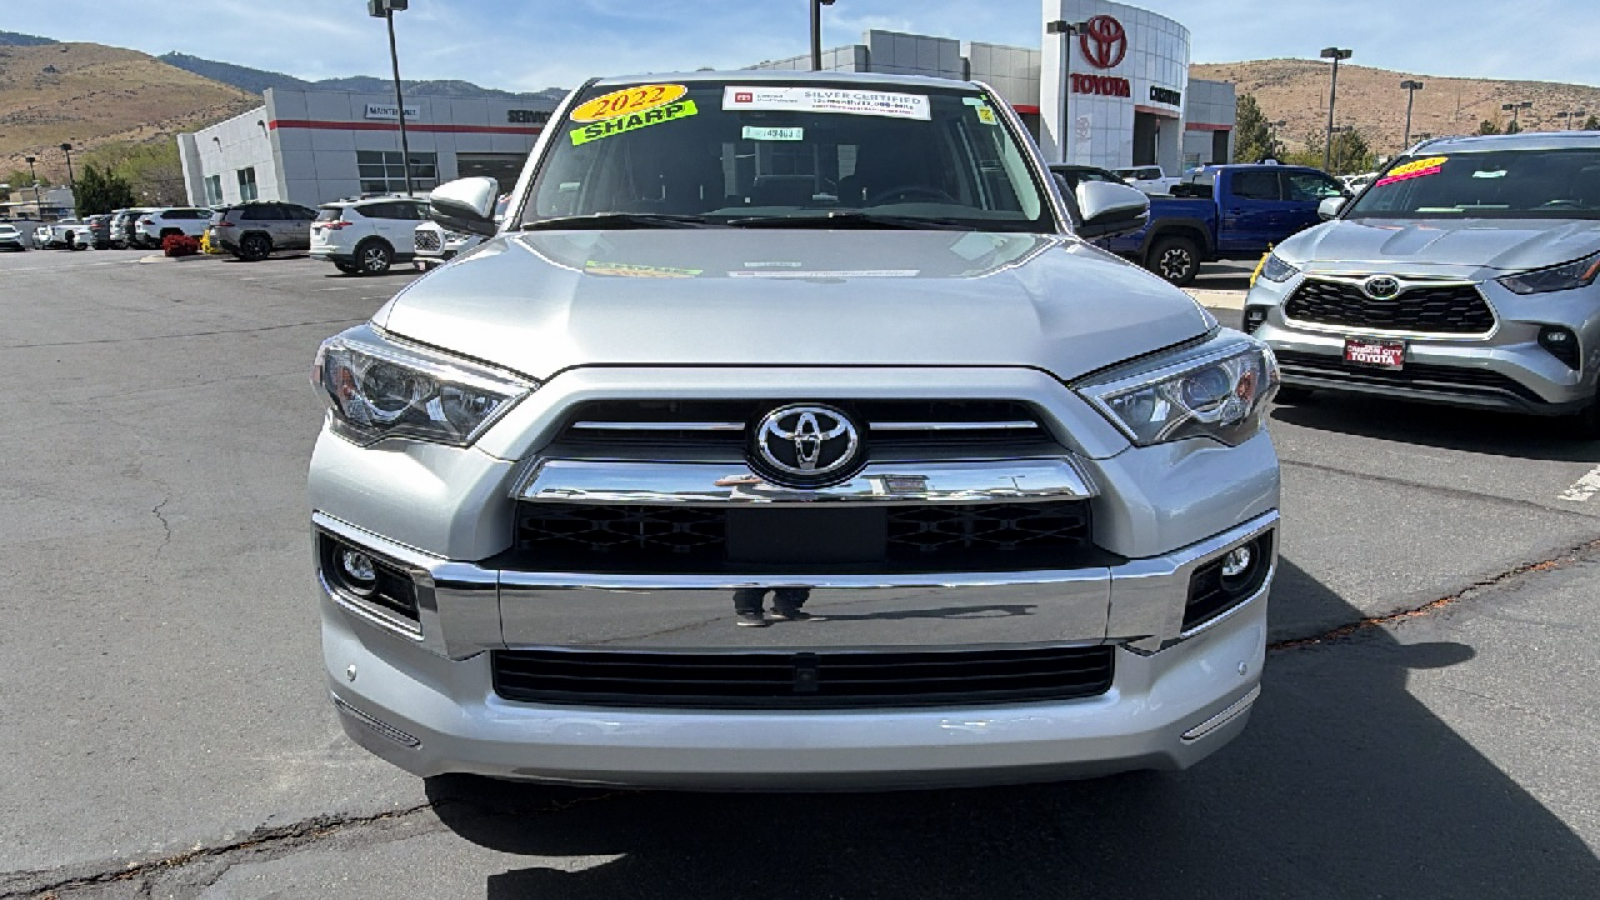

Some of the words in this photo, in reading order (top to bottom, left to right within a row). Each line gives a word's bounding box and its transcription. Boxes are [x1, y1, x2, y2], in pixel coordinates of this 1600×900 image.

[804, 90, 851, 99] SILVER
[853, 93, 921, 105] CERTIFIED
[1070, 73, 1131, 98] TOYOTA
[591, 87, 666, 118] 2022
[584, 104, 684, 139] SHARP
[1351, 352, 1396, 366] TOYOTA
